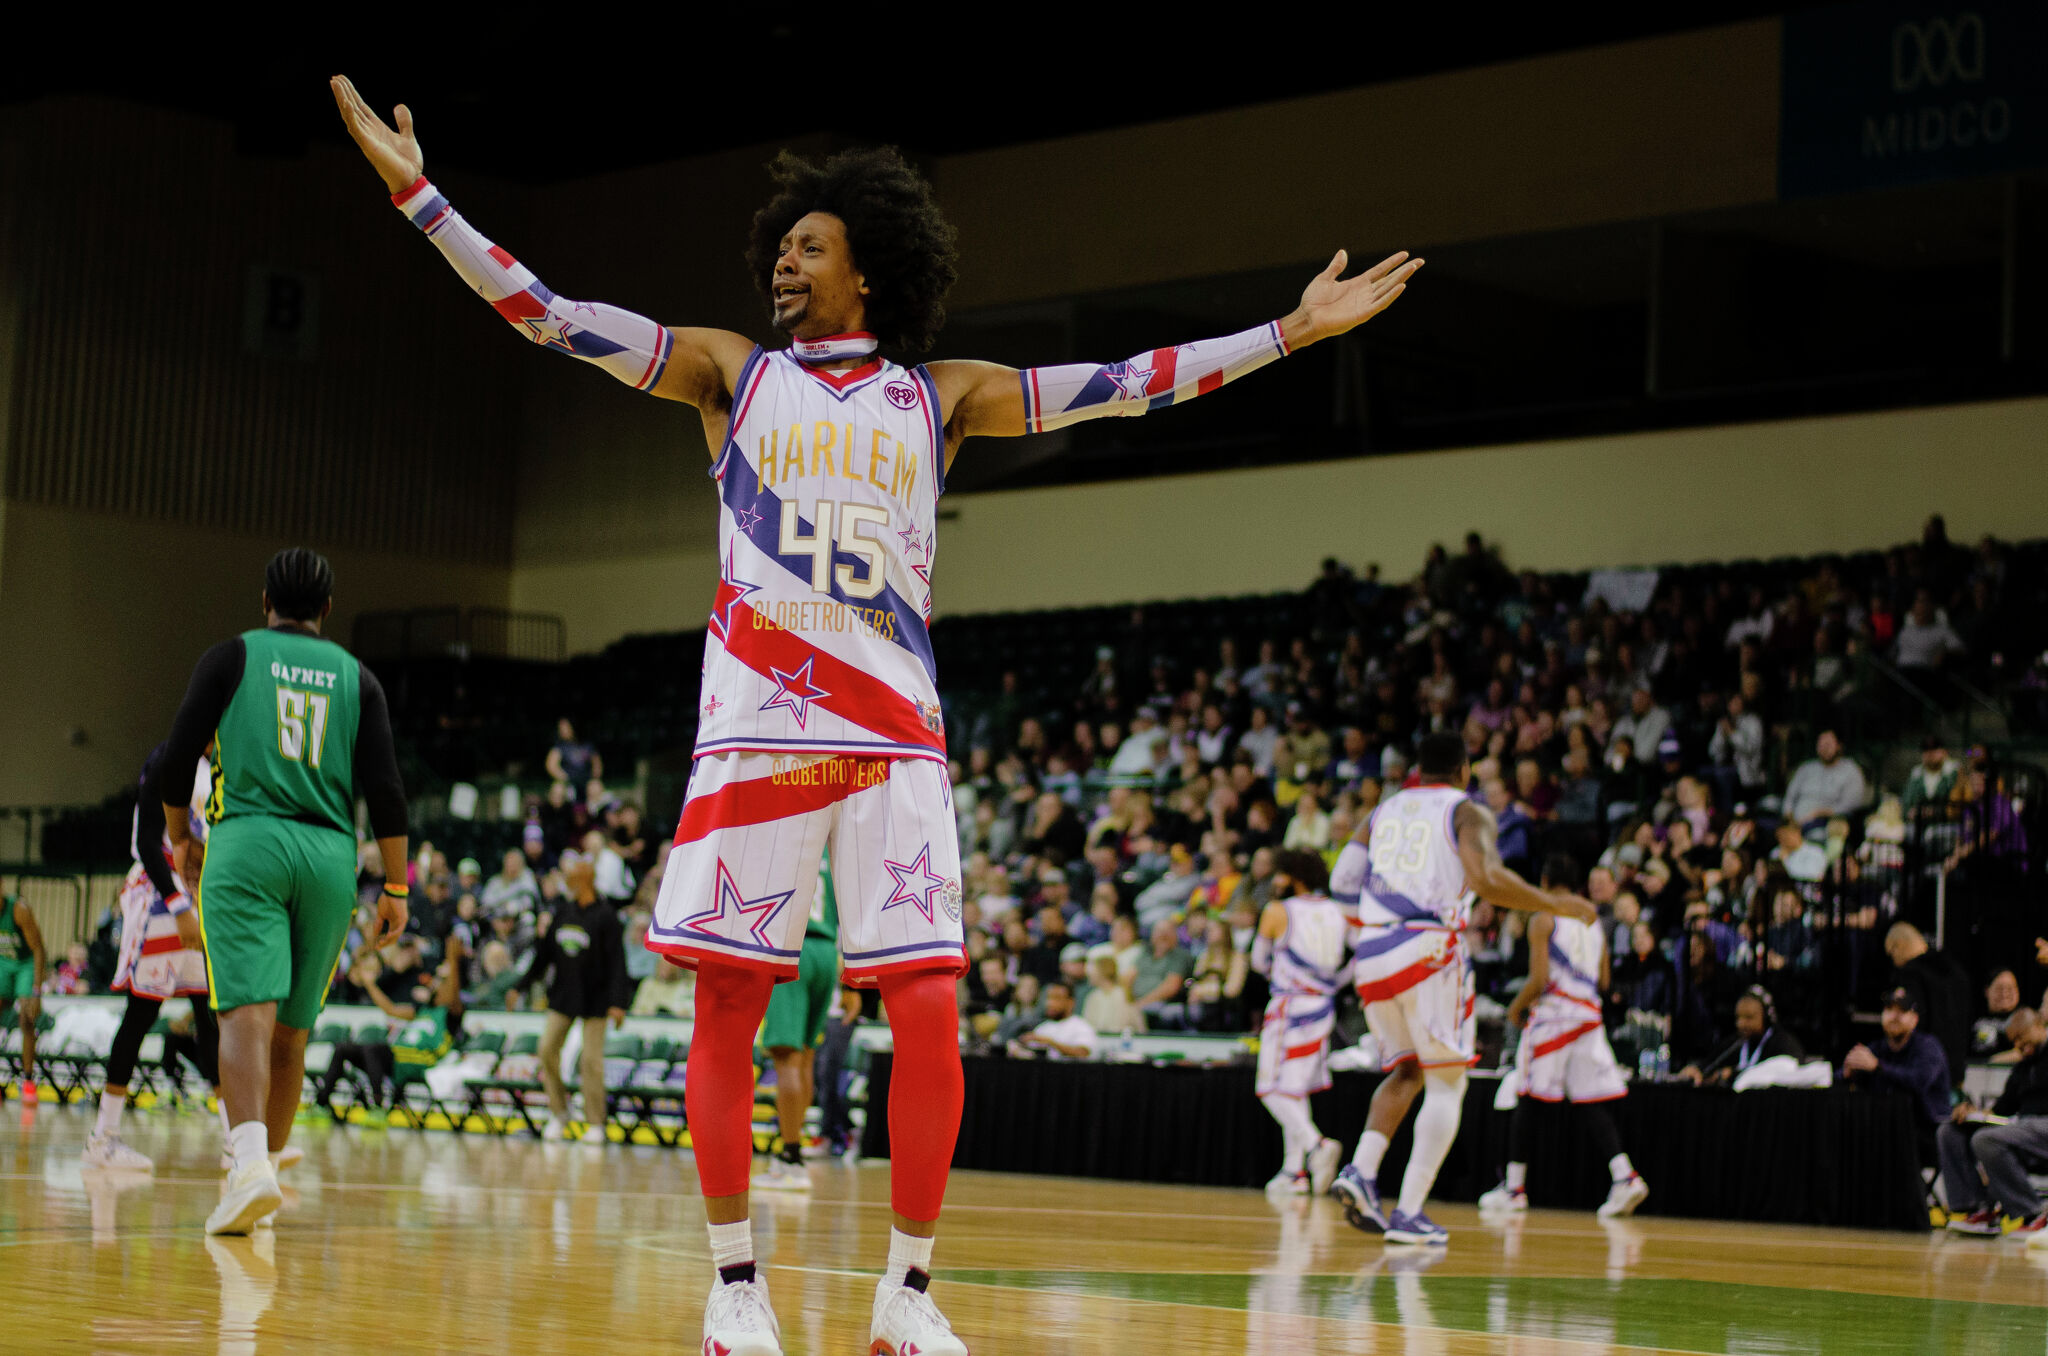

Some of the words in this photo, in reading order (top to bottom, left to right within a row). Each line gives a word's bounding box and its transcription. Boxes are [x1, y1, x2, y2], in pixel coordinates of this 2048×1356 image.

[1861, 97, 2011, 158] MIDCO
[757, 421, 918, 509] HARLEM
[778, 499, 890, 600] 45
[752, 600, 897, 642] GLOBETROTTERS
[1373, 818, 1432, 873] 23
